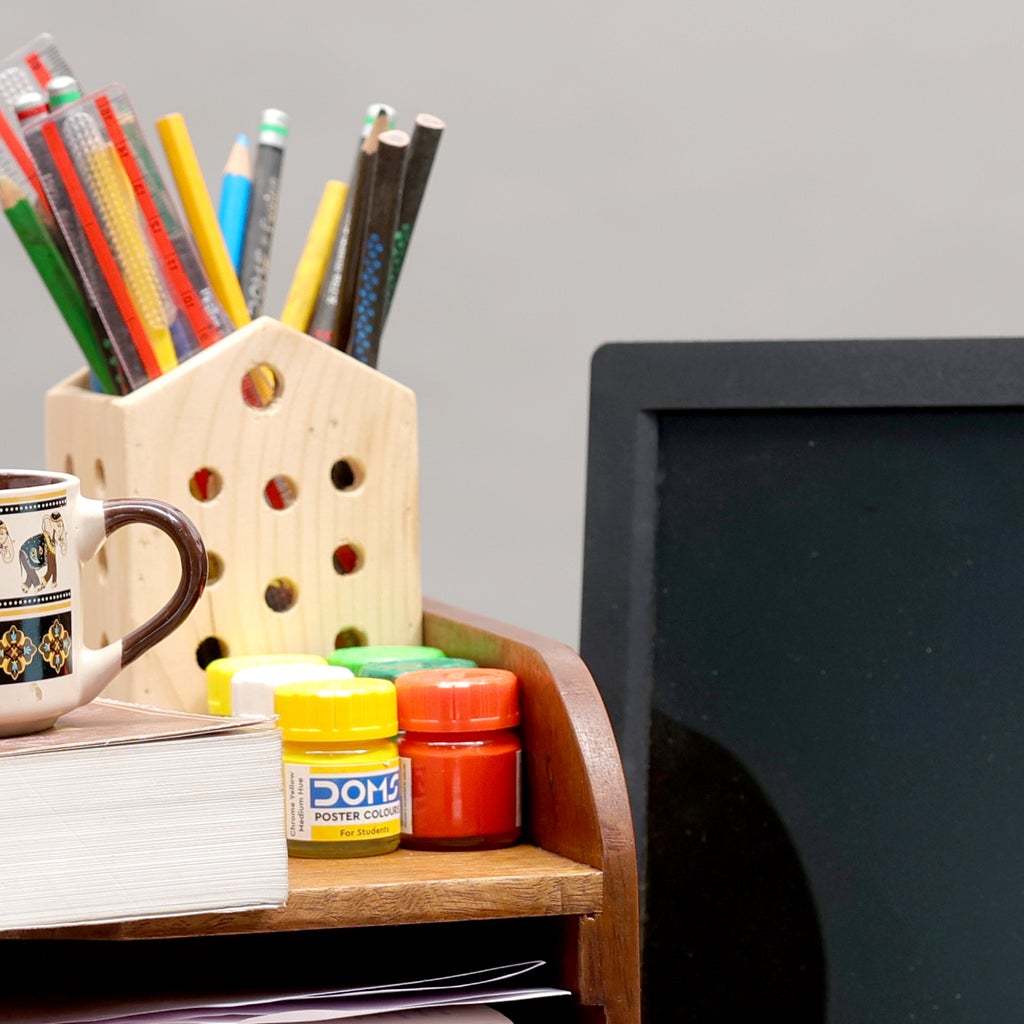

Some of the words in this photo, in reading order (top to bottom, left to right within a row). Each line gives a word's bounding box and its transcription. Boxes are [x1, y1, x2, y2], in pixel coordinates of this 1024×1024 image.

[314, 773, 399, 807] DOMS
[315, 811, 360, 822] POSTER
[340, 829, 355, 837] For
[357, 827, 390, 836] Students
